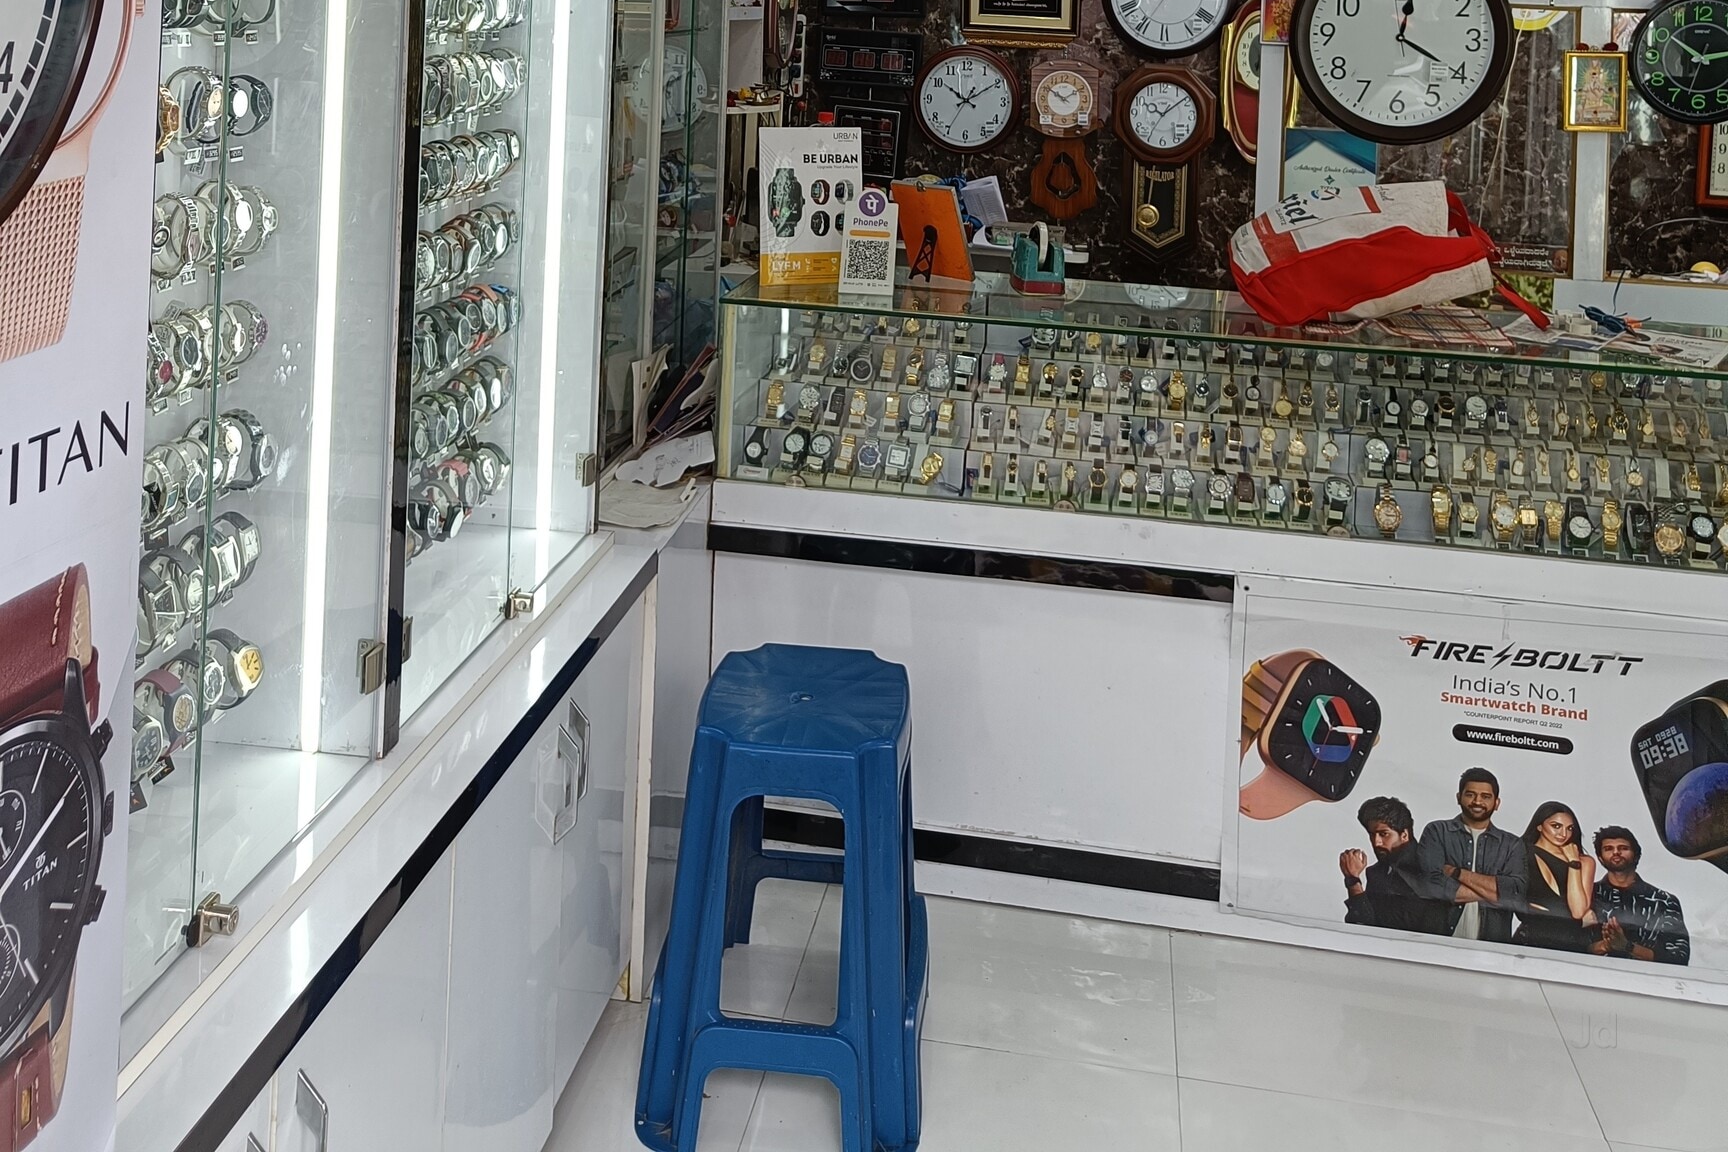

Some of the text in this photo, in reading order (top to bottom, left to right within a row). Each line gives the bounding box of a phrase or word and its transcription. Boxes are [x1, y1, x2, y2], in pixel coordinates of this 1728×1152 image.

[1673, 10, 1686, 27] 11
[1694, 6, 1713, 22] 12
[1320, 22, 1336, 47] 9
[1465, 28, 1481, 52] 3
[1652, 28, 1670, 43] 10
[1646, 49, 1660, 64] 9
[961, 61, 973, 71] 12
[1330, 56, 1346, 80] 8
[1451, 61, 1467, 85] 4
[933, 78, 943, 88] 10
[994, 79, 1001, 88] 2
[1651, 72, 1664, 86] 8
[926, 94, 932, 104] 9
[1356, 80, 1372, 103] 7
[1424, 84, 1440, 107] 5
[1668, 88, 1681, 102] 7
[1000, 98, 1007, 107] 3
[1389, 90, 1405, 114] 6
[1691, 94, 1705, 109] 6
[962, 130, 968, 140] 6
[803, 153, 858, 163] BE URBAN
[853, 217, 889, 228] PhonePe
[0, 401, 130, 506] ITAN
[1453, 674, 1577, 704] India's No.1
[1441, 691, 1588, 721] Smartwatch Brand
[1514, 716, 1538, 726] REPORT
[1466, 729, 1560, 750] www.fireboltt.com
[1655, 726, 1677, 742] 0928
[1641, 737, 1689, 769] 09:38
[22, 857, 58, 891] TITAN
